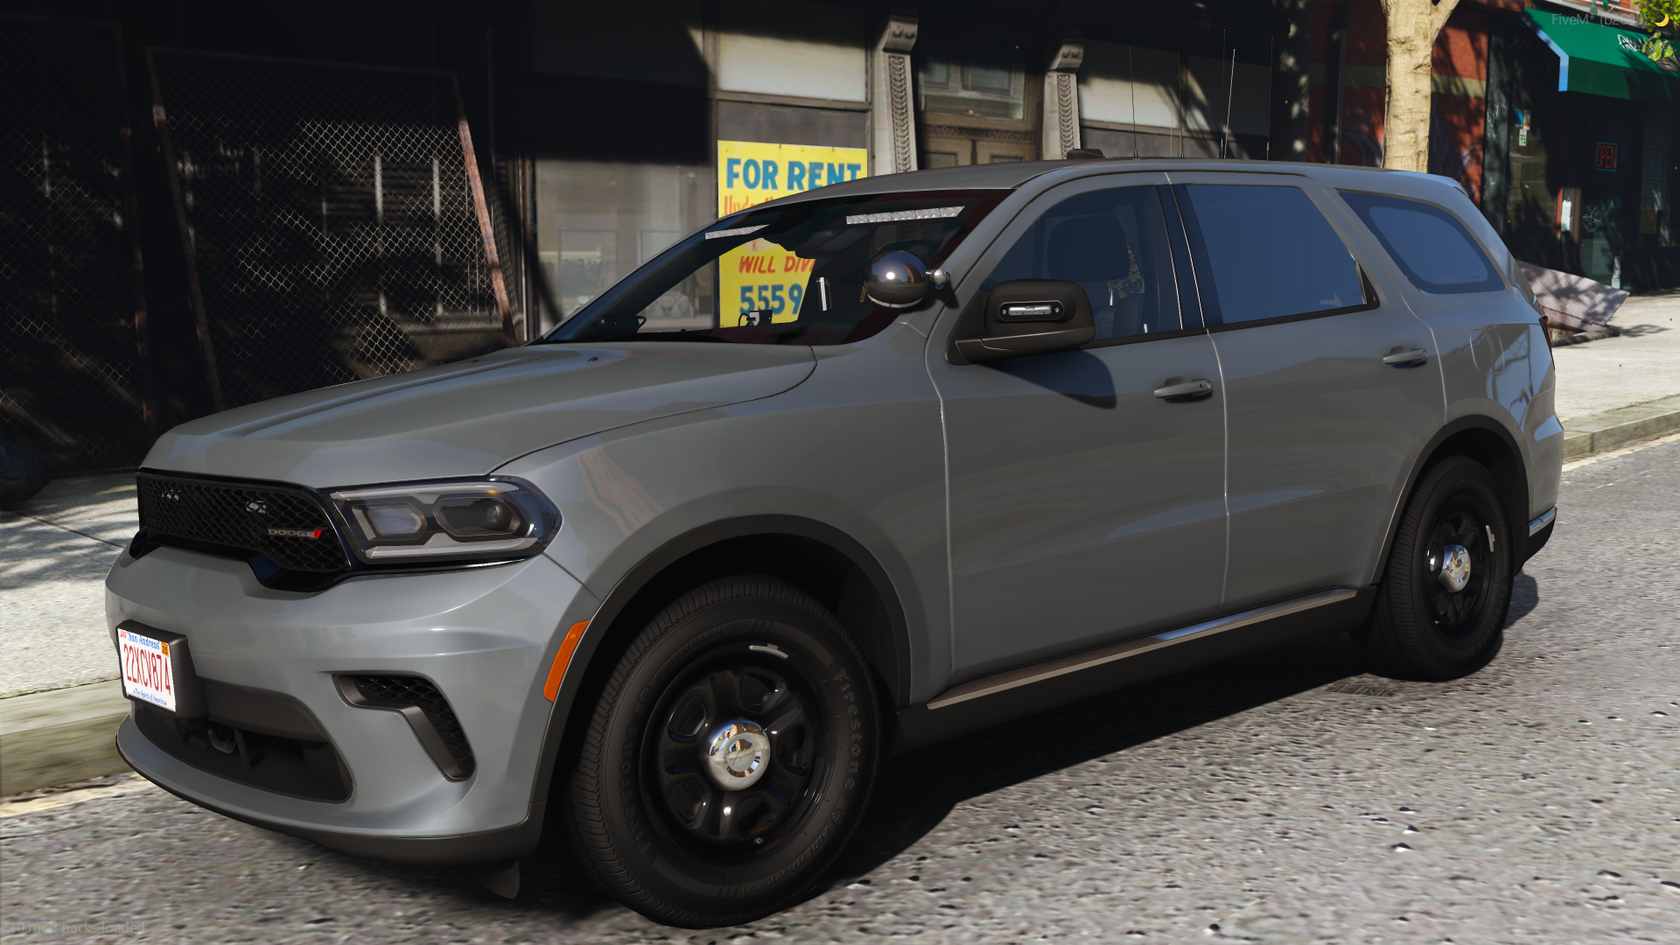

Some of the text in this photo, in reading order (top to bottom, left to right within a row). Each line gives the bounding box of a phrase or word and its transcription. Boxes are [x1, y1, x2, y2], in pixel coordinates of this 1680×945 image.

[1596, 144, 1617, 169] OPEN
[726, 158, 862, 191] FOR RENT
[738, 255, 776, 274] WILL
[739, 283, 804, 317] 5559
[268, 528, 316, 538] DODGE
[127, 631, 139, 643] San
[139, 634, 160, 650] Andreas
[123, 643, 172, 696] 22XCV874
[832, 667, 862, 790] Firestone
[618, 723, 652, 856] Firestone
